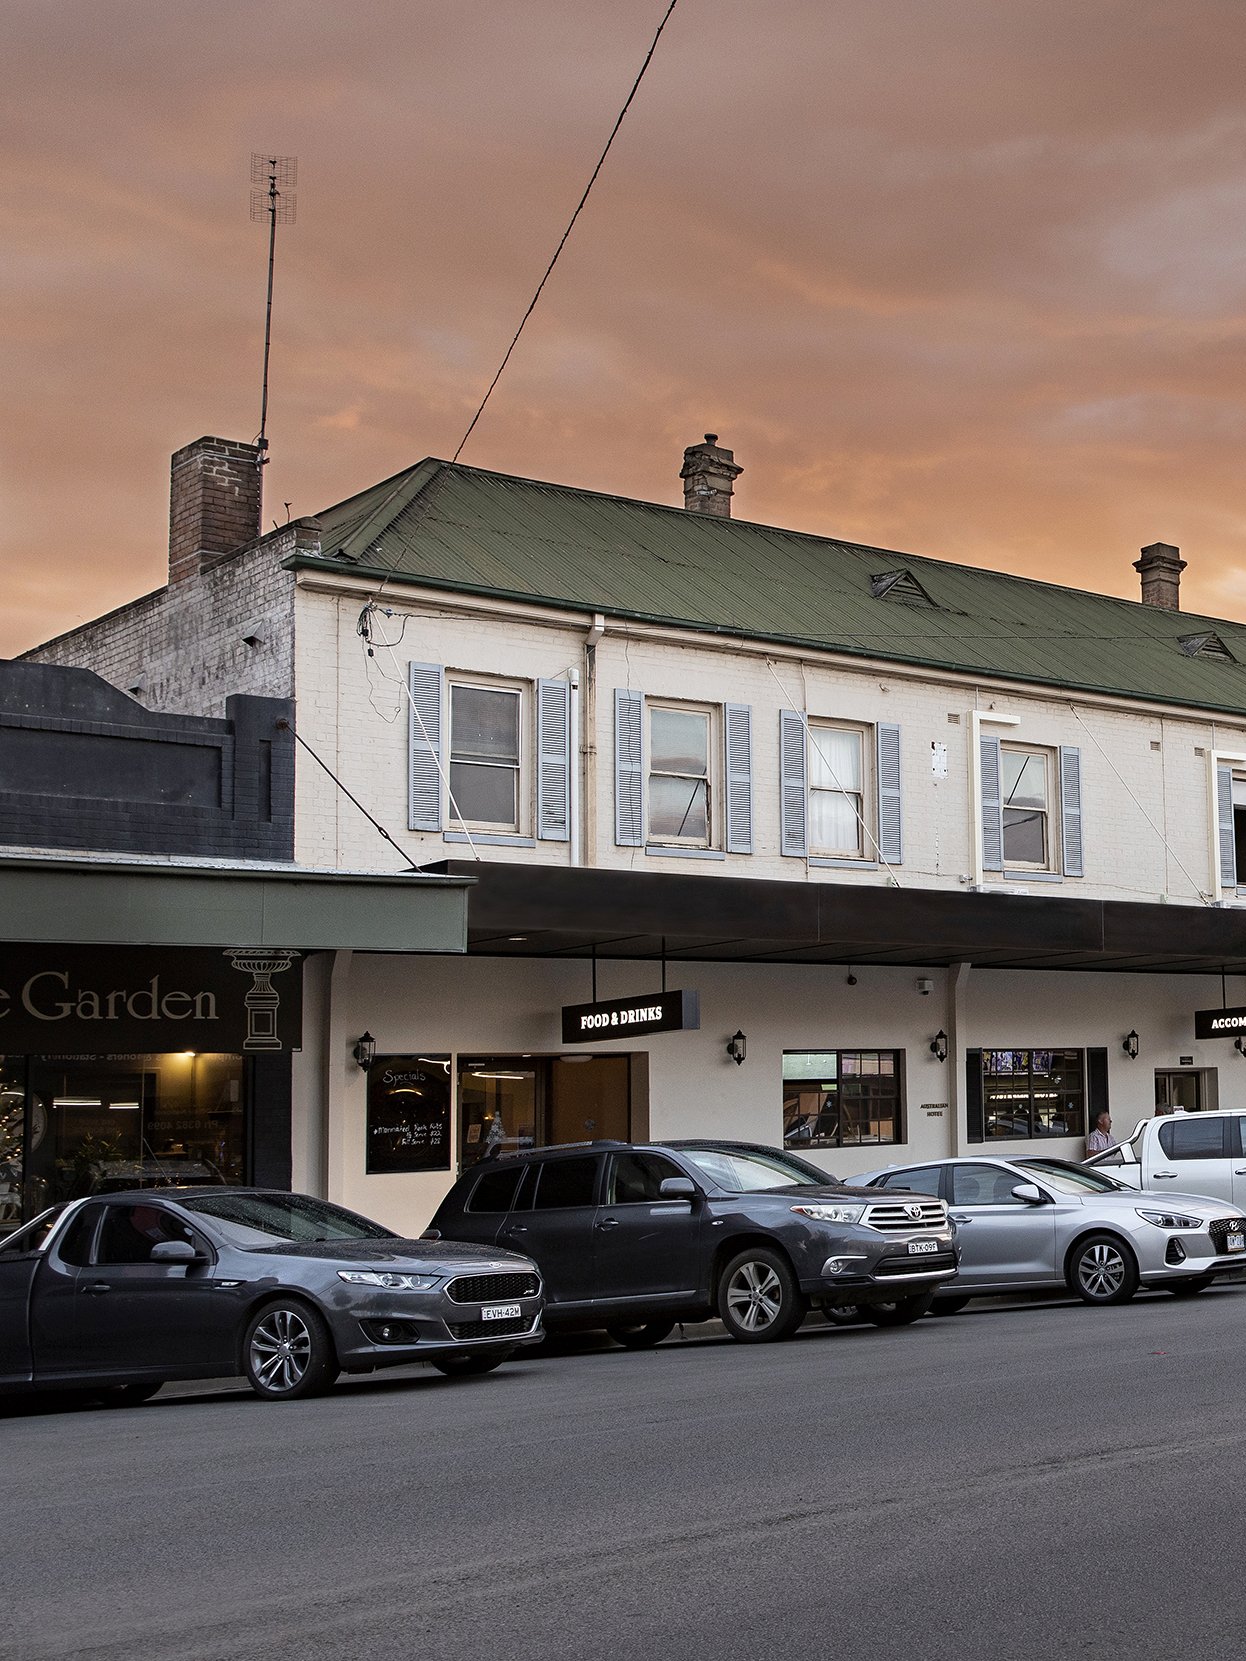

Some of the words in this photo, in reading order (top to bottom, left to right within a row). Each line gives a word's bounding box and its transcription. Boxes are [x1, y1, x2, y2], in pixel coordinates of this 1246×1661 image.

[22, 971, 220, 1021] Garden
[580, 1013, 610, 1030] FOOD
[611, 1011, 619, 1026] &
[620, 1005, 663, 1025] DRINKS
[383, 1068, 426, 1087] Specials
